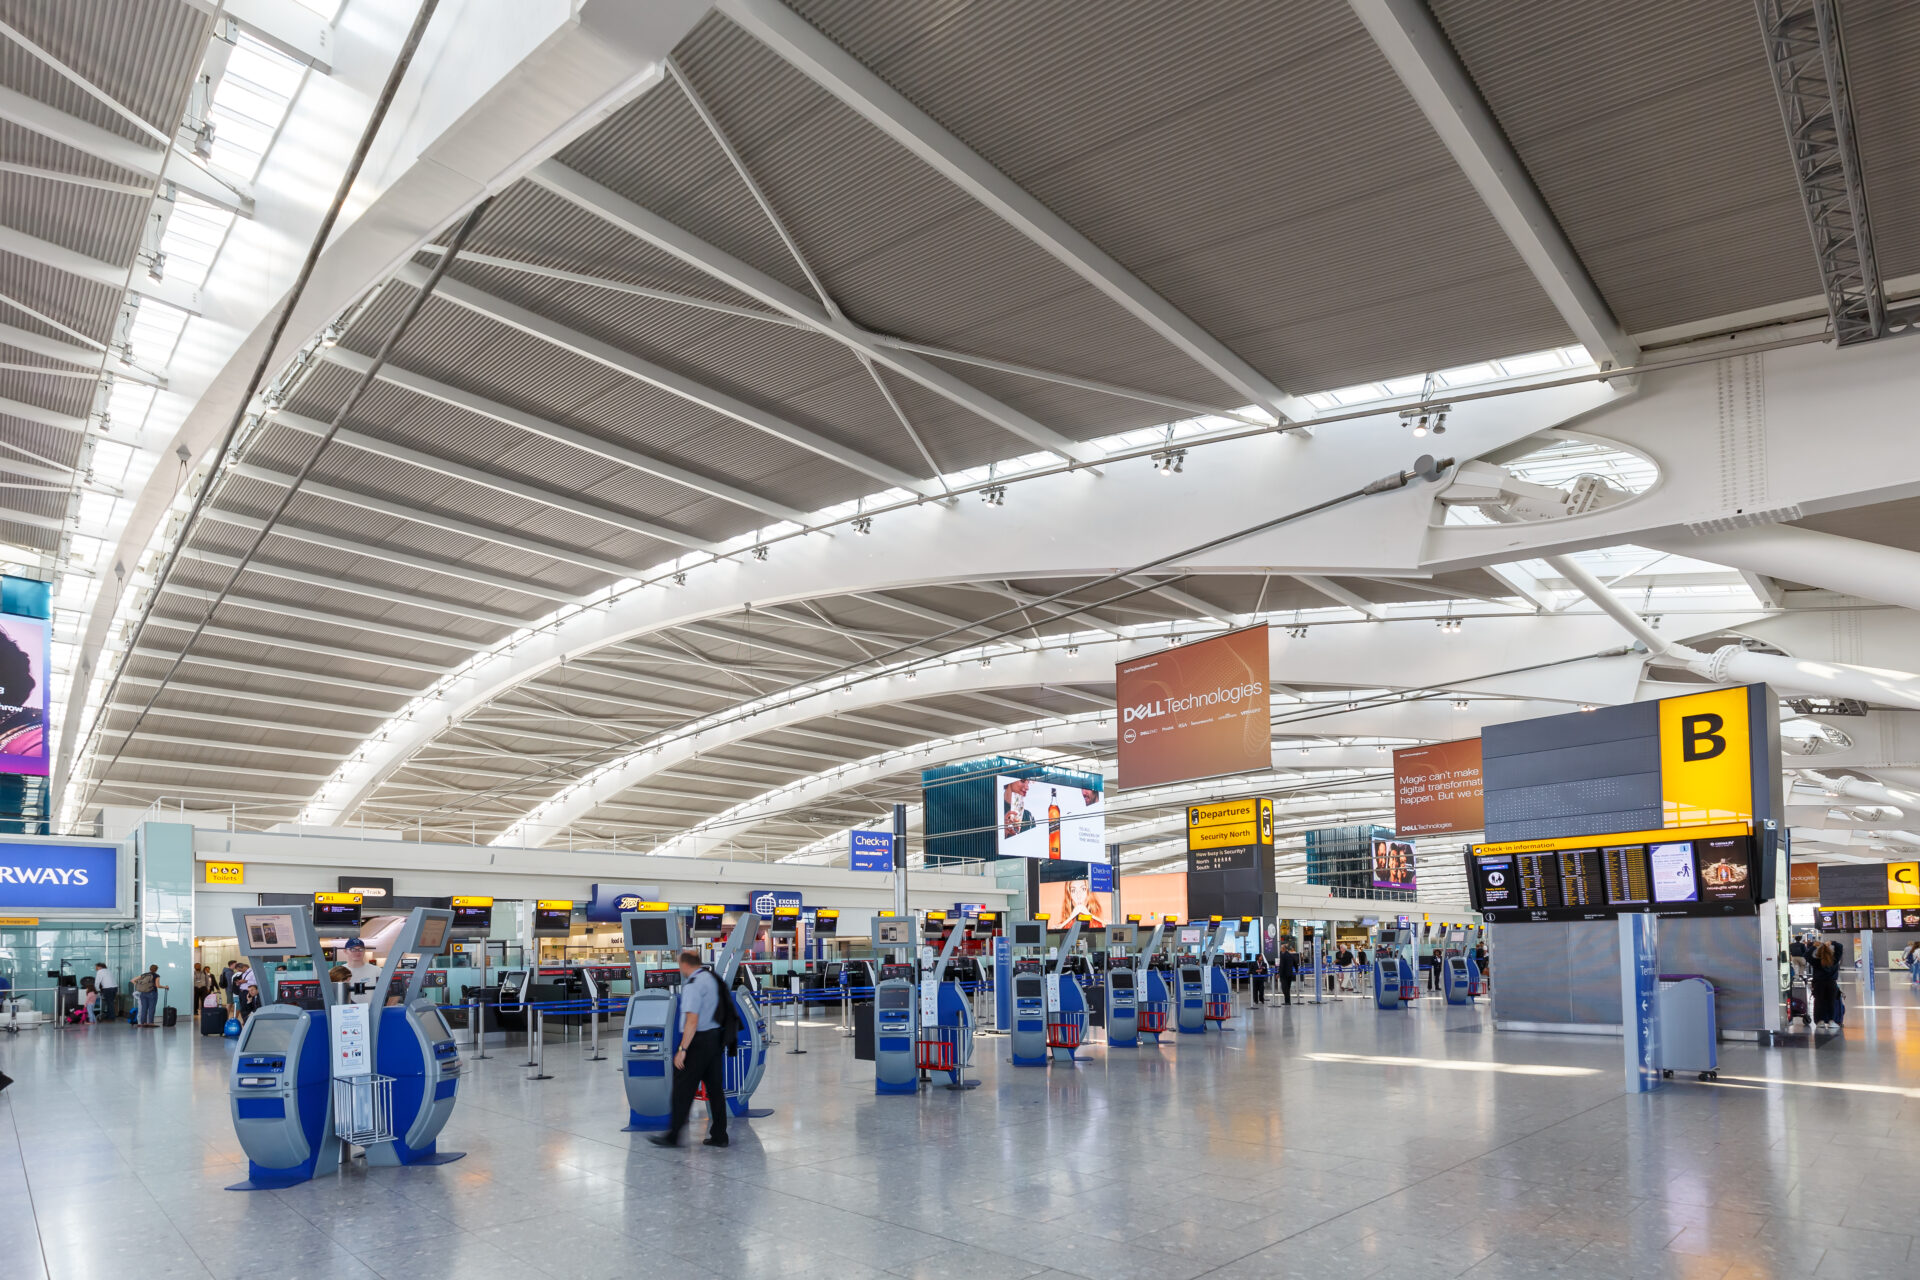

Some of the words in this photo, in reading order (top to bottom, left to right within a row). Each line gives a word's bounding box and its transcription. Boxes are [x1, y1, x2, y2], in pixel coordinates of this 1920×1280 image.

[1124, 701, 1165, 723] DELL
[1164, 682, 1262, 713] Technologies
[1682, 713, 1726, 762] B
[1400, 775, 1427, 785] Magic
[1429, 771, 1451, 781] can't
[1454, 768, 1479, 777] make
[1400, 784, 1426, 795] digital
[1400, 794, 1435, 805] happen.
[1438, 791, 1454, 801] But
[1457, 790, 1471, 798] we
[1201, 808, 1250, 819] Departures
[855, 835, 889, 846] Check-in
[1201, 832, 1228, 840] Security
[0, 866, 89, 886] RWAYS
[1092, 866, 1111, 875] Check-in
[1894, 868, 1911, 883] C
